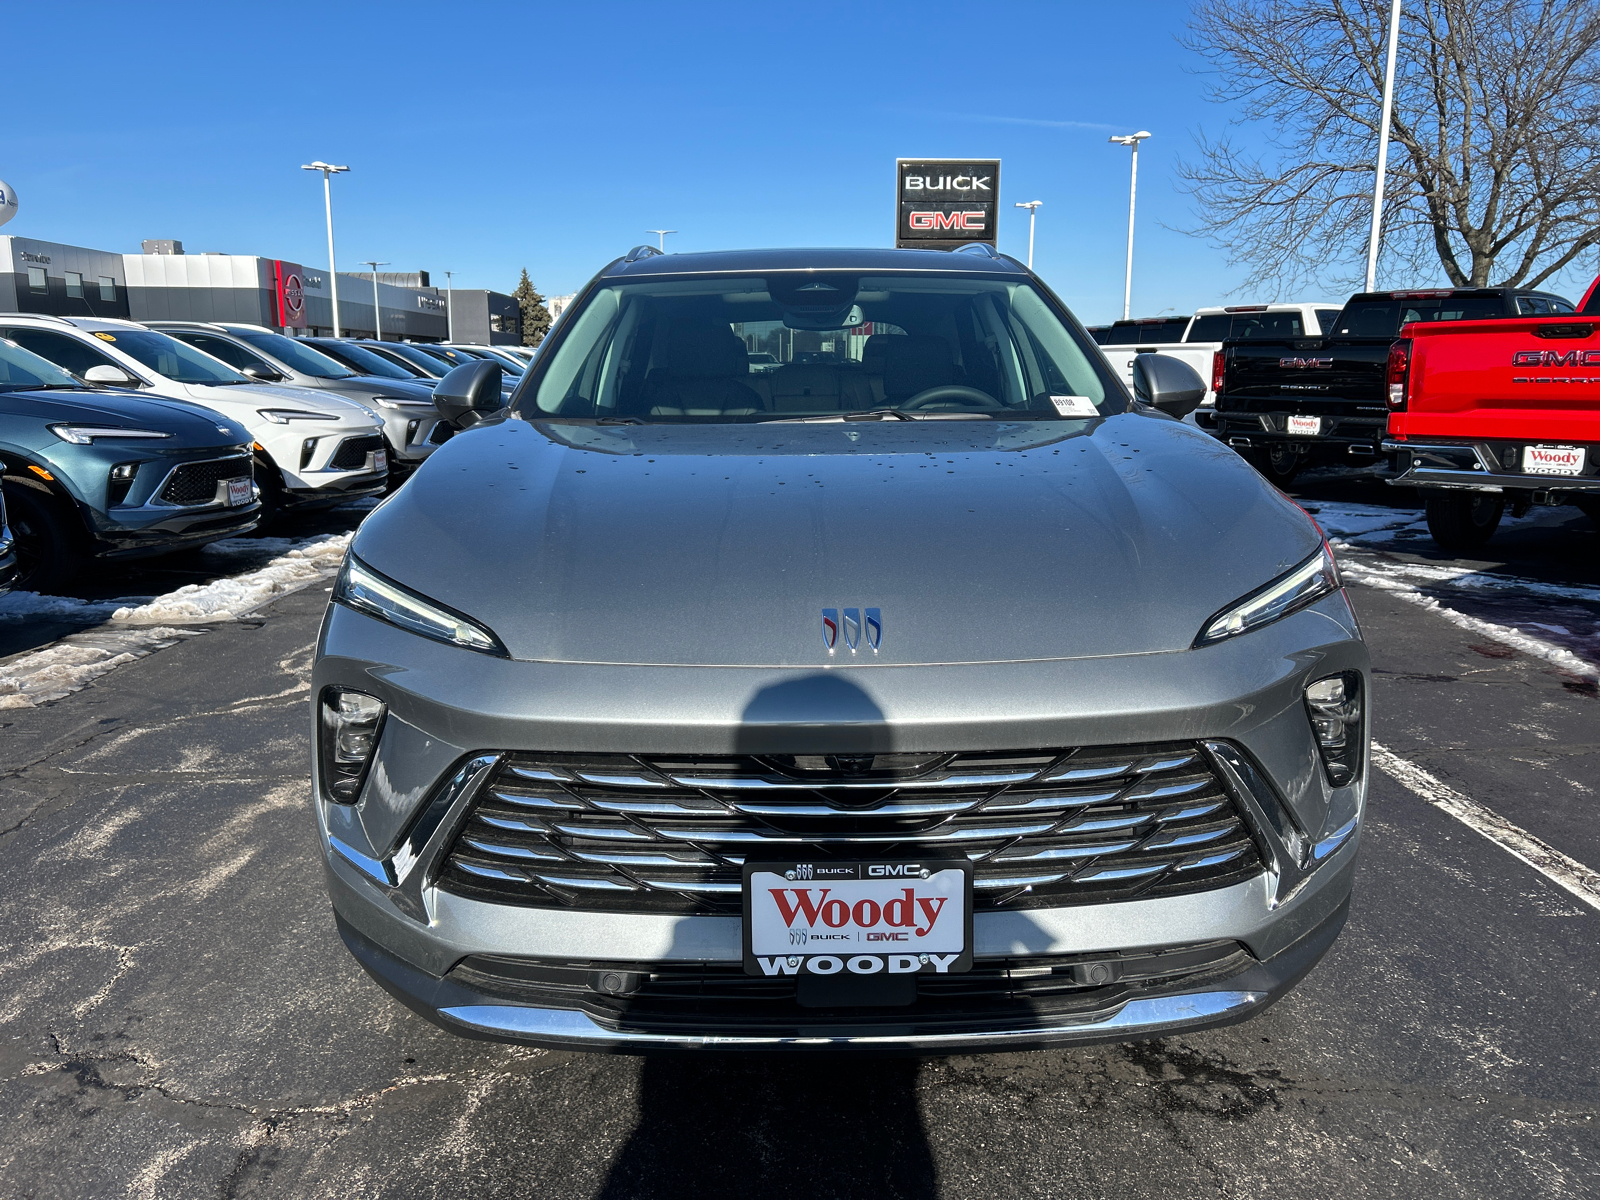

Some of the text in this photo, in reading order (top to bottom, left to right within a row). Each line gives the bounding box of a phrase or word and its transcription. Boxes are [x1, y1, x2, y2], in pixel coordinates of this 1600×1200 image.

[905, 176, 991, 190] BUICK
[909, 211, 985, 230] GMC
[1280, 357, 1333, 369] GMC
[1512, 350, 1600, 367] GMC
[1292, 419, 1317, 430] Woody
[1530, 450, 1580, 466] Woody
[1525, 467, 1581, 477] WOODY
[230, 483, 249, 496] Woody
[868, 863, 922, 877] GMC
[768, 887, 948, 937] Woody
[866, 932, 909, 942] GMC
[757, 954, 959, 975] WOODY
